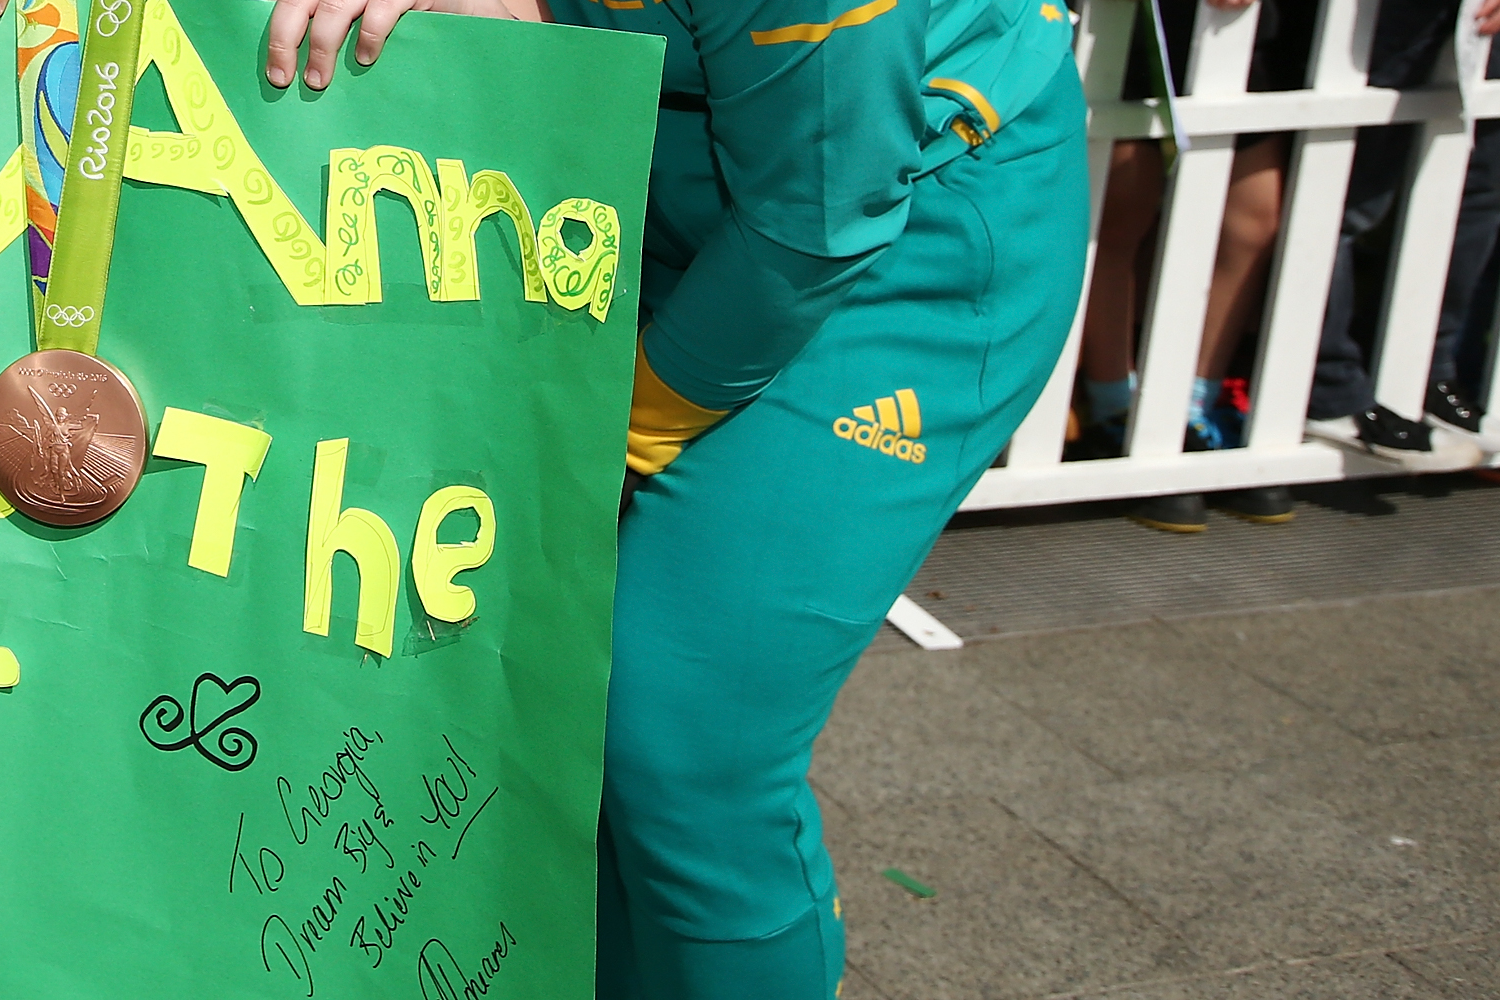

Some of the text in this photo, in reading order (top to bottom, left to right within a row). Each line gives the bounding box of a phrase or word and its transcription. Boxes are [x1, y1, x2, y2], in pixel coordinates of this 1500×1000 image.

[833, 417, 927, 465] adidas
[153, 406, 496, 659] The
[230, 813, 285, 894] To
[261, 876, 347, 997] Dream
[334, 818, 395, 874] Big
[349, 870, 422, 969] Believe
[410, 840, 437, 868] in
